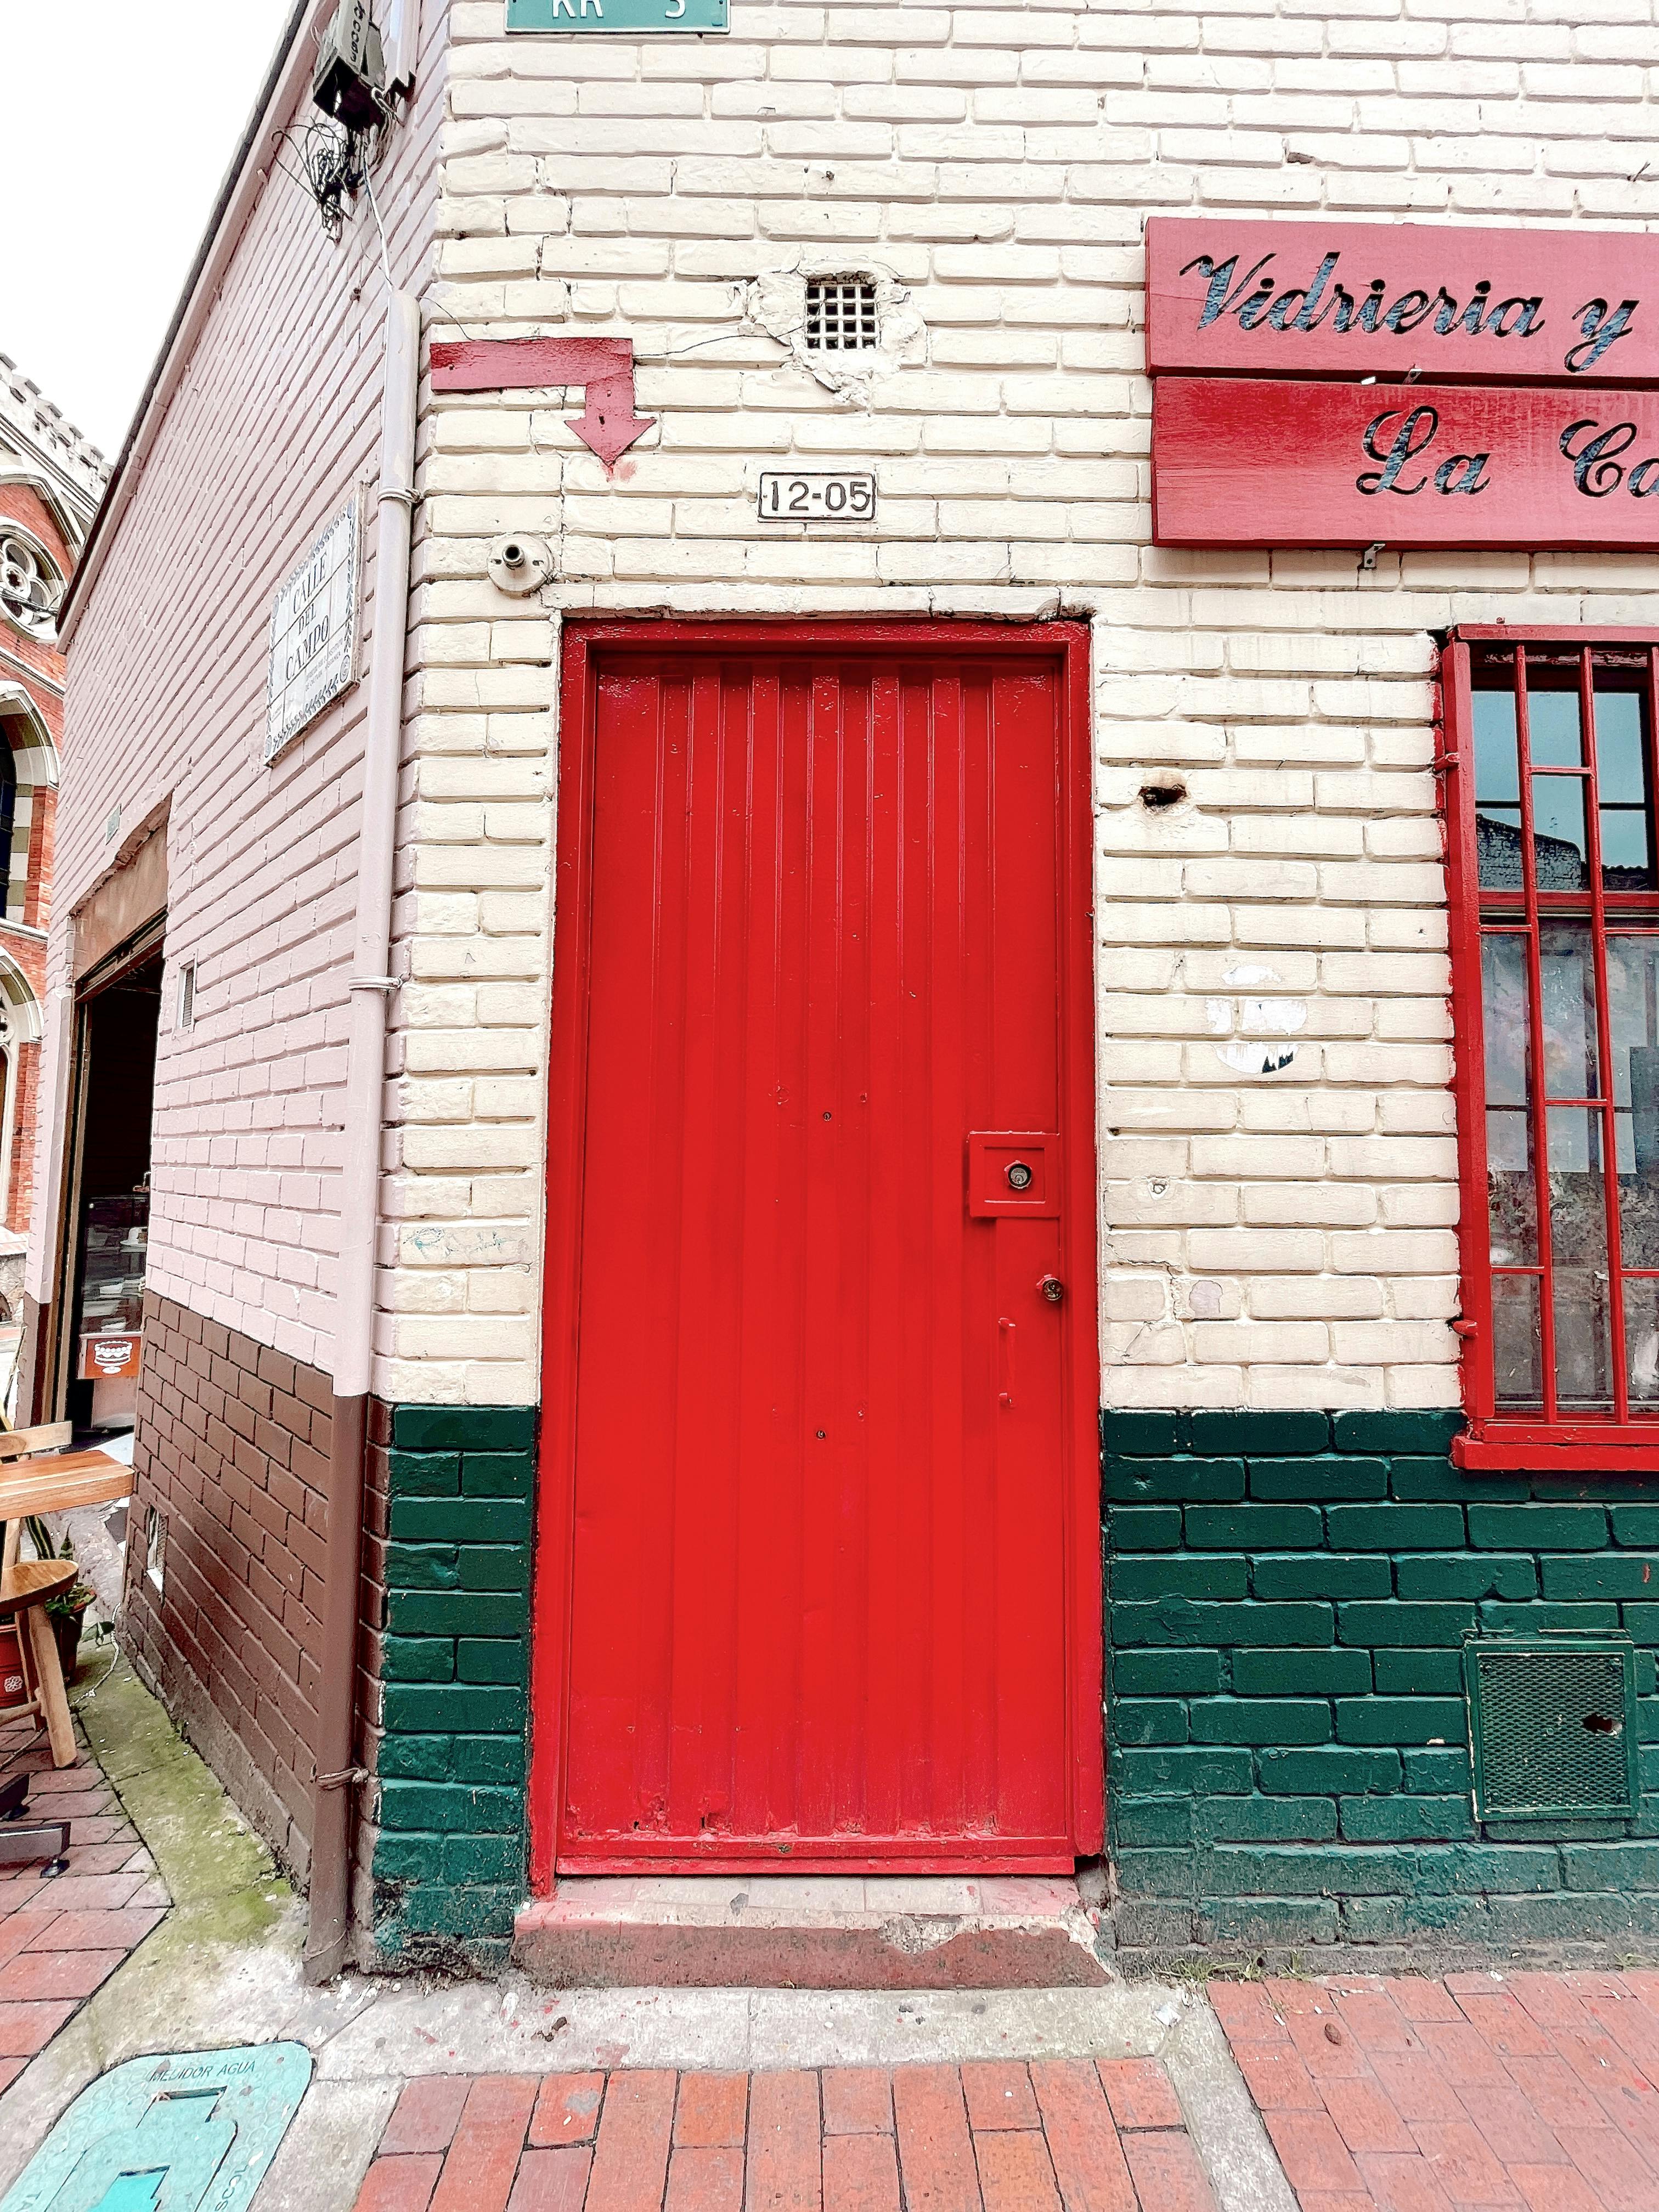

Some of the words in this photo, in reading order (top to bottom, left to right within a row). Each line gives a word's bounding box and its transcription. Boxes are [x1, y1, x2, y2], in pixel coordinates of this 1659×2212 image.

[1180, 251, 1545, 337] Vidrieria
[1564, 297, 1640, 374] y
[1356, 405, 1491, 495] La
[771, 481, 871, 512] 12-05
[293, 549, 327, 614] CALLE
[286, 615, 329, 681] CAMPO
[298, 602, 317, 636] DEL
[217, 2060, 256, 2077] AGUA
